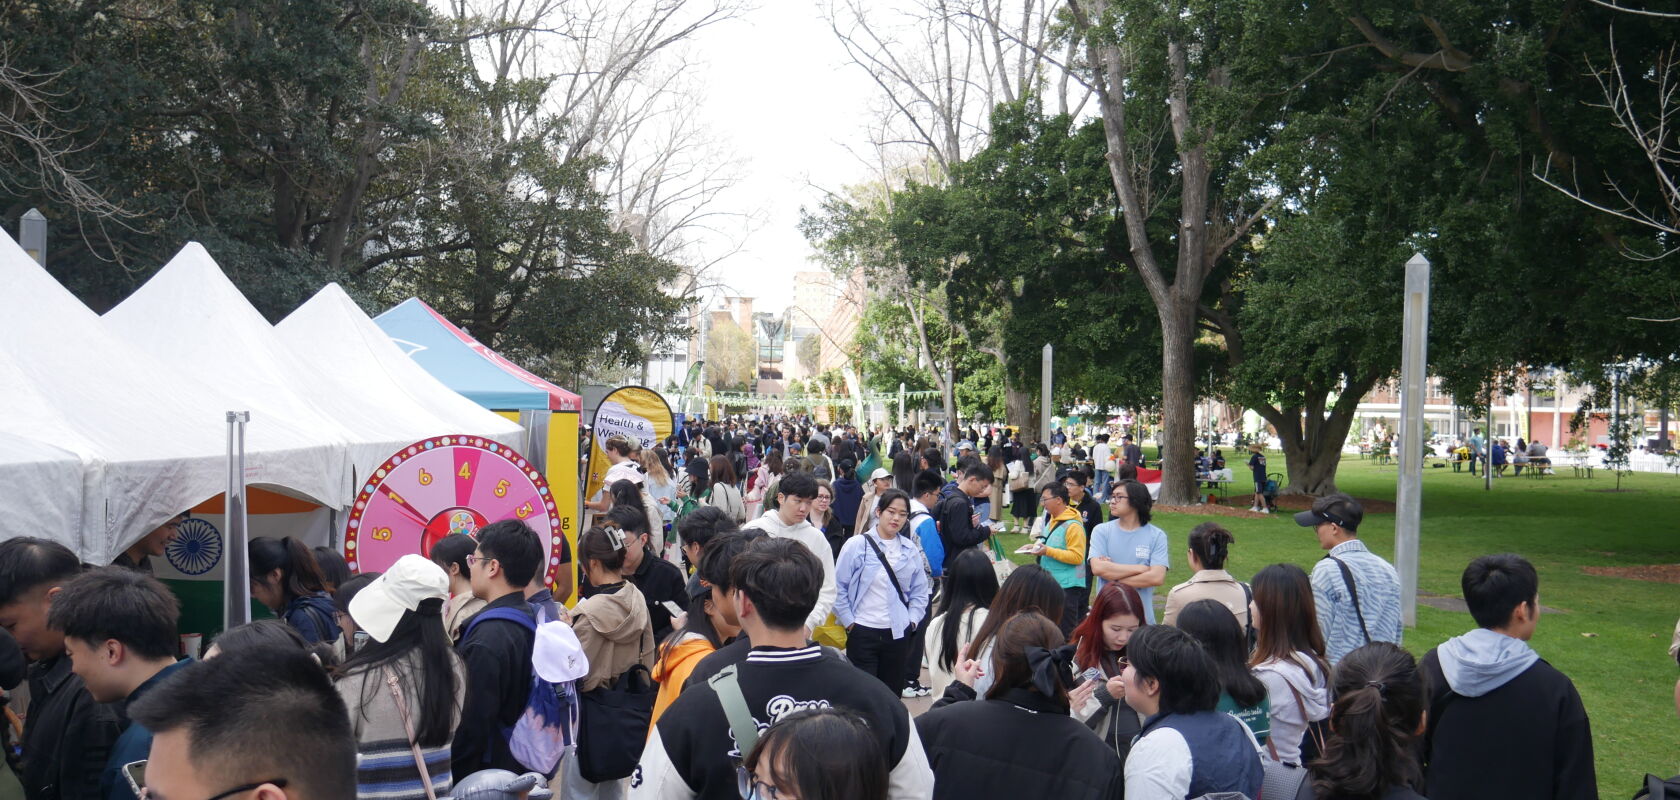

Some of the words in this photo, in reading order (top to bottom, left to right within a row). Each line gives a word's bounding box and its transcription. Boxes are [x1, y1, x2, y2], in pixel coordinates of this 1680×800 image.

[599, 414, 634, 429] Health
[636, 422, 644, 431] &
[417, 467, 433, 486] 6
[458, 461, 471, 480] 4
[493, 478, 511, 498] 5
[388, 491, 405, 504] 1
[515, 501, 534, 519] 3
[371, 526, 393, 541] 5
